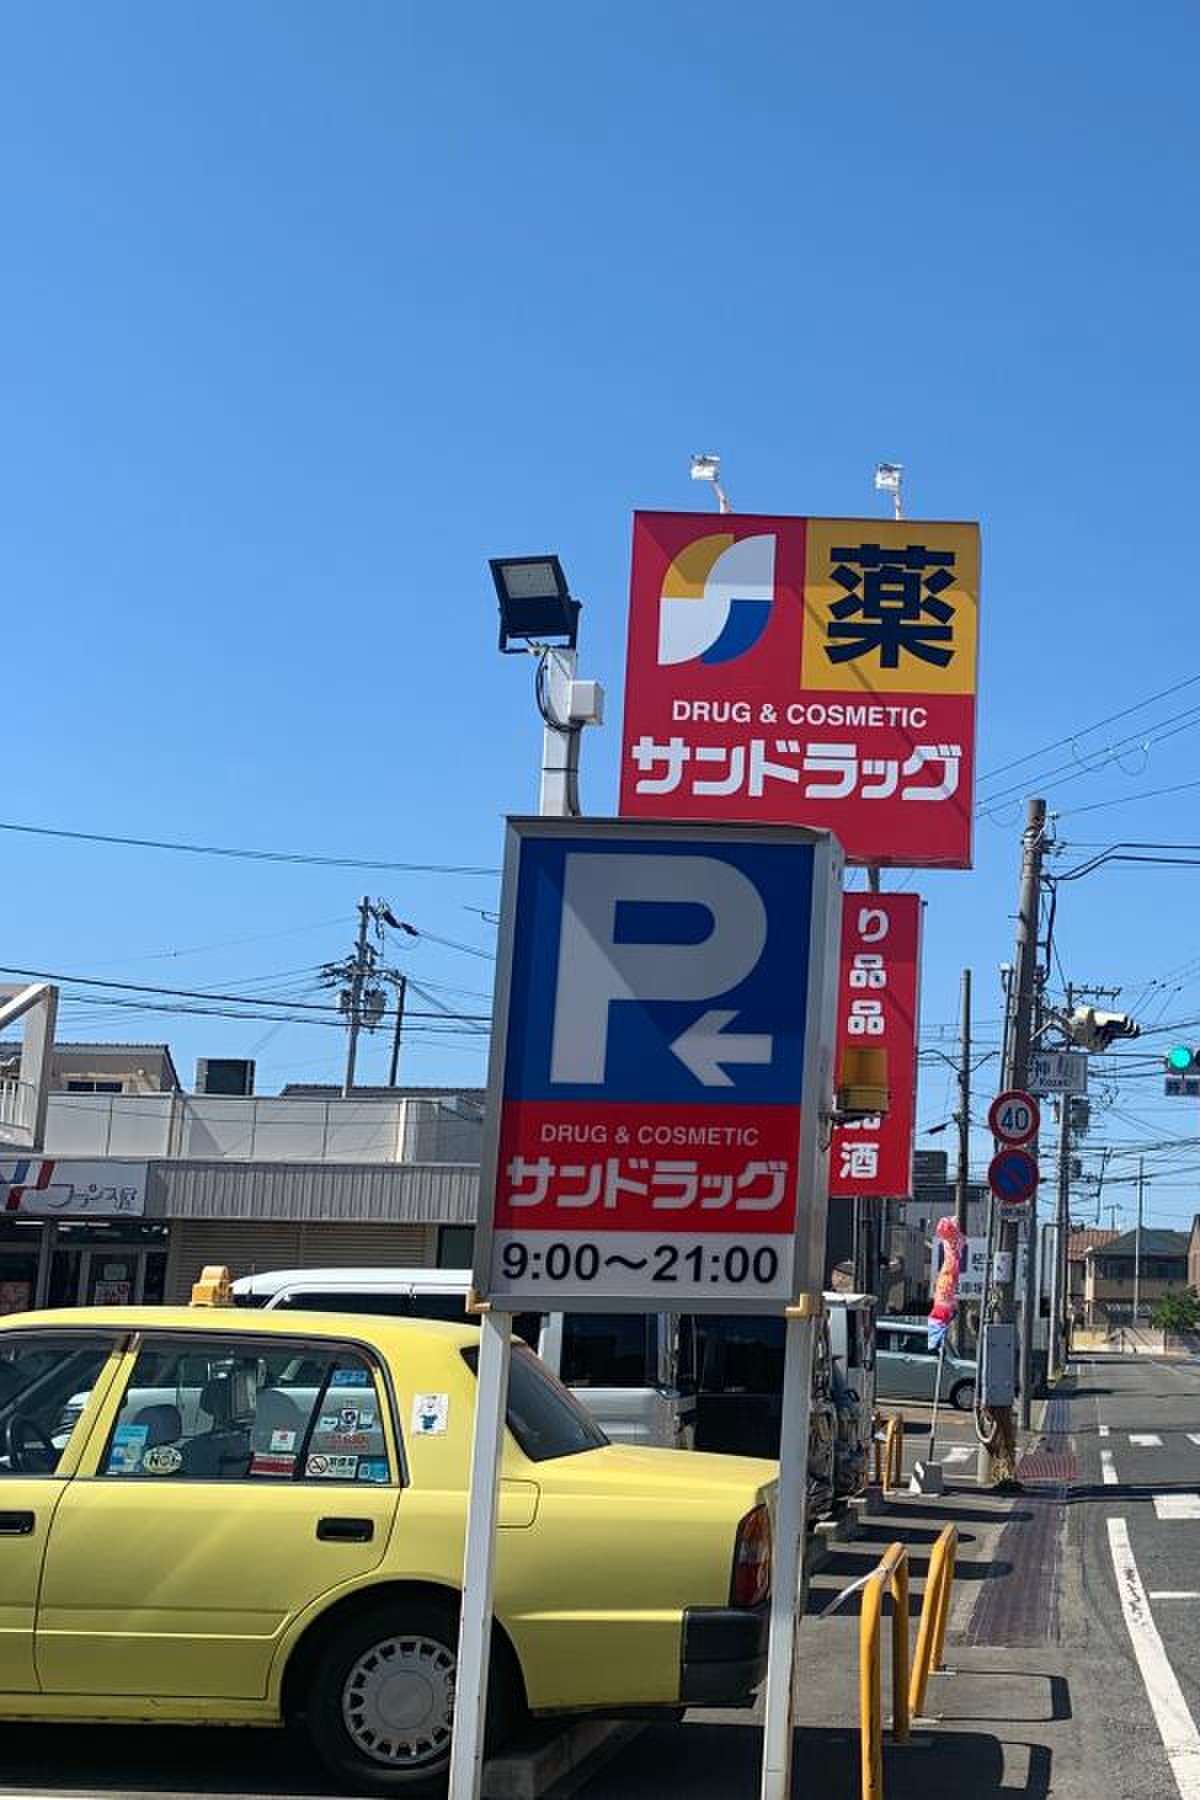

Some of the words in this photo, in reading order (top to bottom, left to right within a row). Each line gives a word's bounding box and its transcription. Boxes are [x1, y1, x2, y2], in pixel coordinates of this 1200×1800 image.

[823, 544, 957, 669] 薬
[672, 700, 751, 724] DRUG
[759, 704, 778, 725] &
[787, 703, 928, 729] COSMETIC
[631, 736, 963, 801] サンドラッグ
[550, 852, 768, 1085] P
[541, 1124, 608, 1144] DRUG
[615, 1125, 631, 1144] &
[638, 1125, 759, 1146] COSMETIC
[1001, 1107, 1030, 1132] 40
[507, 1155, 789, 1211] サンドラッグ
